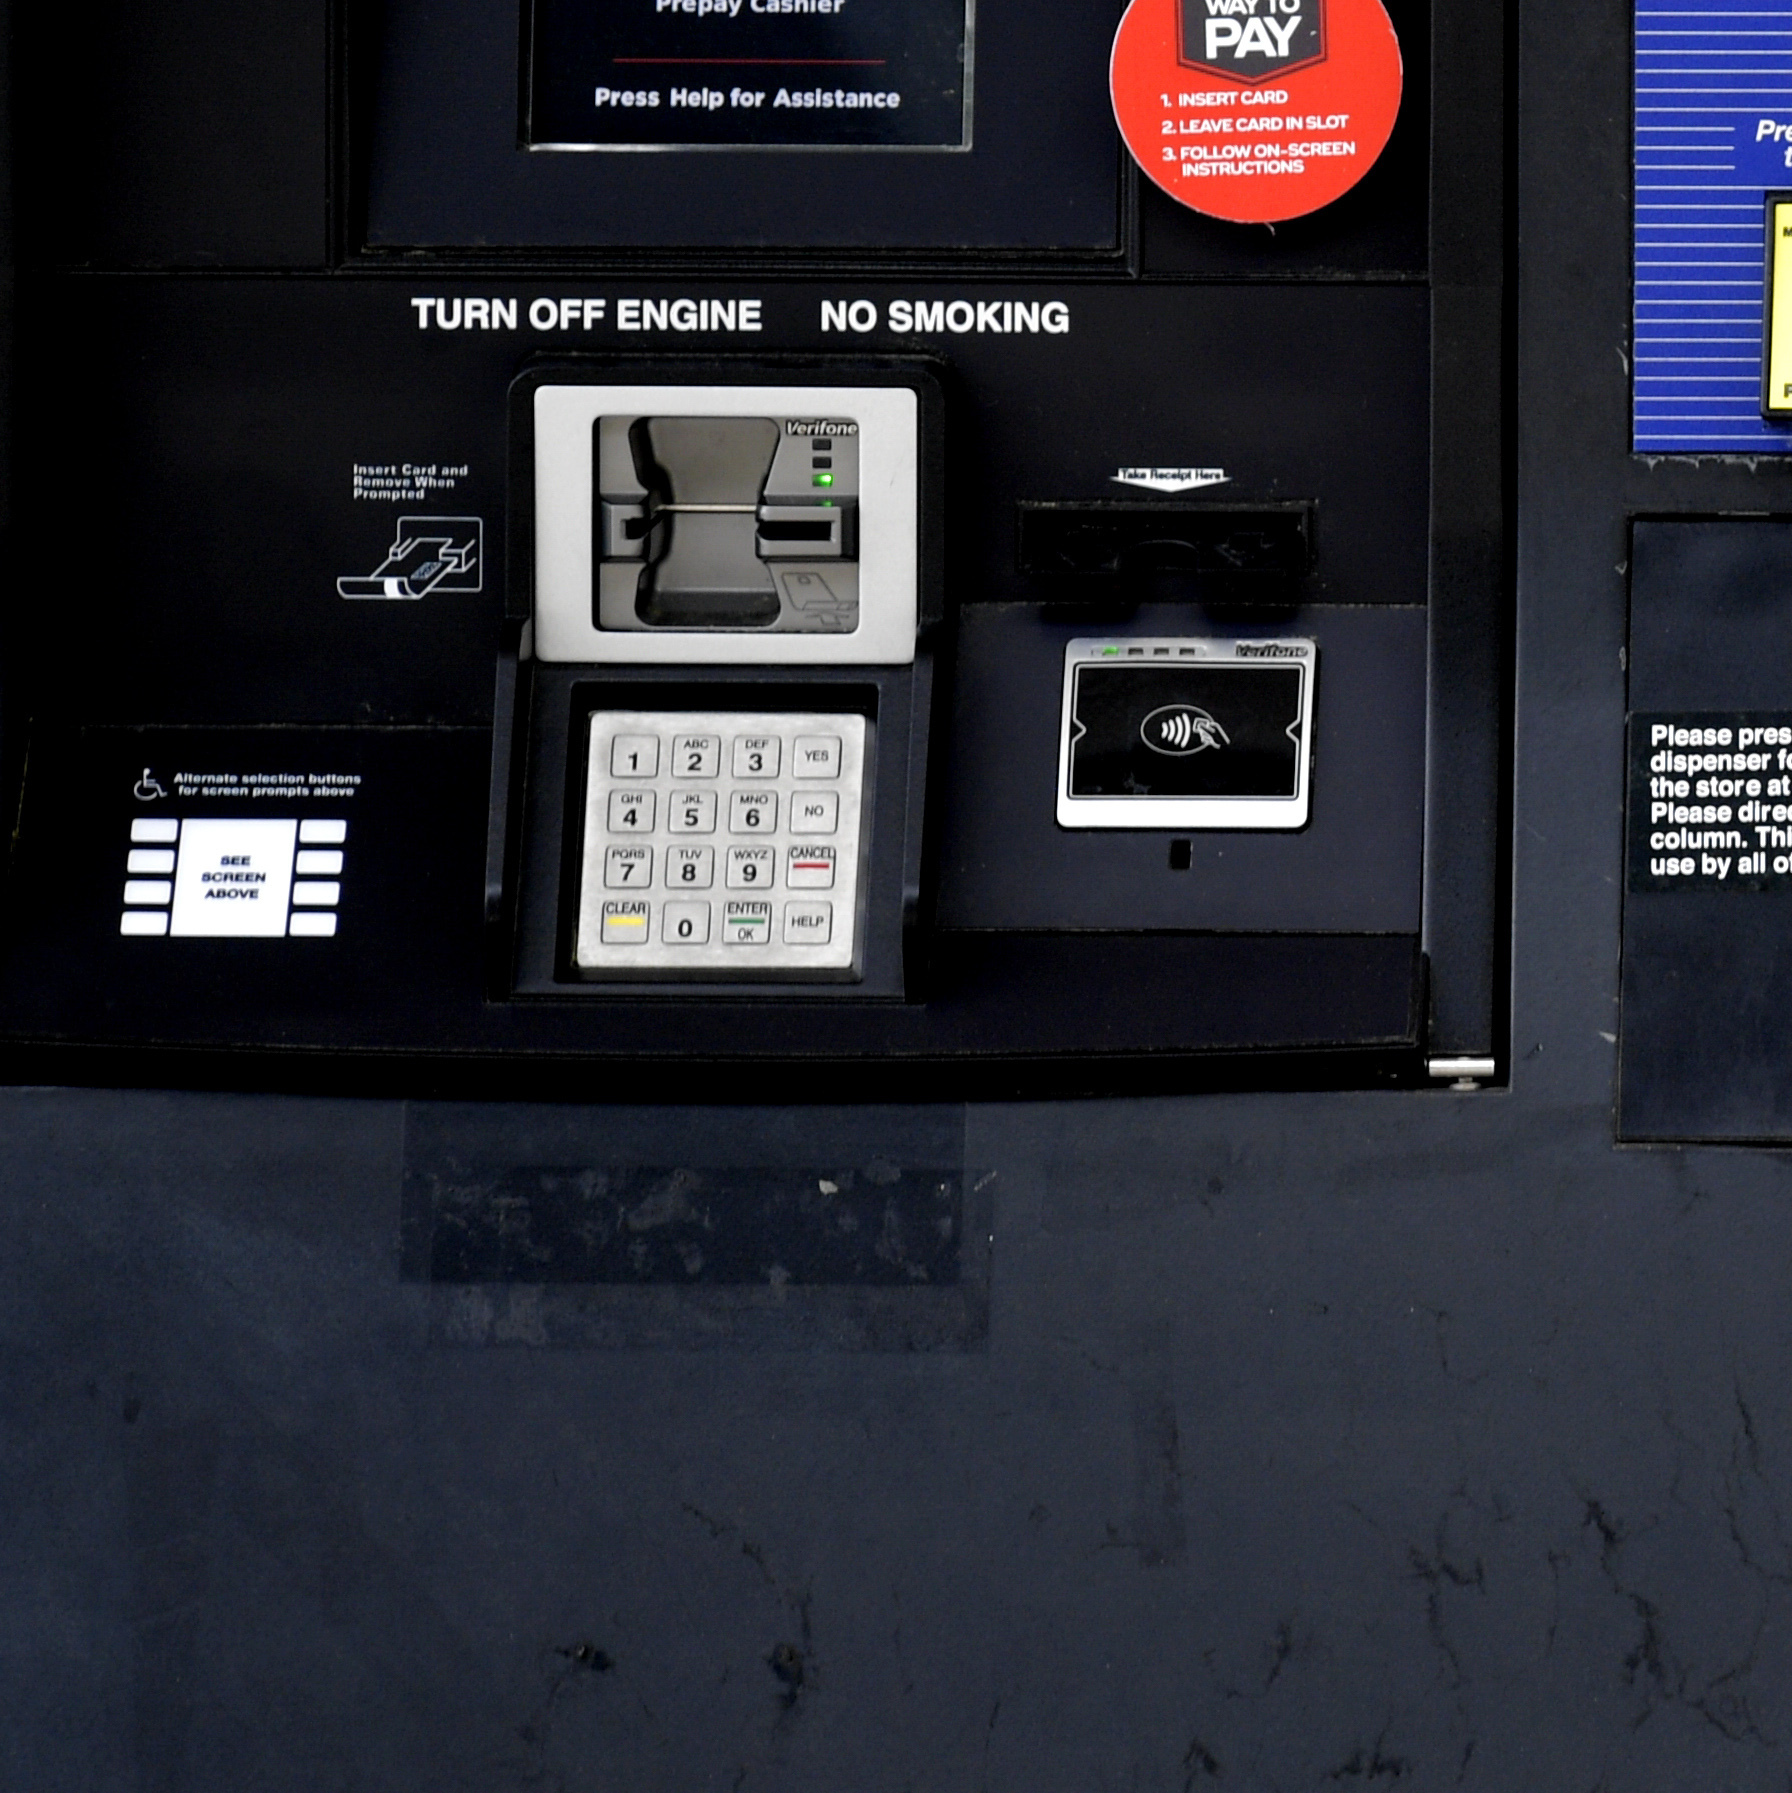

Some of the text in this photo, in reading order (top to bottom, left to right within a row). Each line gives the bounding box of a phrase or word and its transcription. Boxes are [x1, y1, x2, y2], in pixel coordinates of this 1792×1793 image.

[1205, 15, 1301, 59] PAY
[595, 88, 900, 110] Press Help for Assistance
[1161, 90, 1288, 107] 1. INSERT CARD
[1162, 115, 1349, 134] 2. LEAVE CARD IN SLOT
[1163, 142, 1355, 160] 3. FOLLOW ON-SCREEN
[1183, 160, 1304, 176] INSTRUCTIONS
[411, 298, 762, 331] TURN OFF ENGINE
[822, 300, 1069, 333] NO SMOKING
[354, 464, 467, 475] Insert Card and
[354, 476, 454, 487] Remove When
[354, 488, 424, 501] Prompted
[1652, 725, 1732, 746] Please
[627, 752, 639, 770] 1
[688, 754, 702, 771] 2
[749, 754, 763, 771] 3
[805, 750, 828, 762] YES
[1651, 747, 1771, 774] dispenser
[173, 773, 361, 785] Alternate selection buttons
[1650, 774, 1690, 798] the
[1697, 777, 1762, 797] store
[1767, 775, 1790, 796] at
[178, 785, 354, 798] for screen prompts above
[623, 809, 637, 826] 4
[685, 809, 699, 826] 5
[746, 809, 760, 827] 6
[805, 806, 824, 817] NO
[1652, 802, 1732, 823] Please
[1651, 827, 1747, 849] column.
[220, 856, 251, 866] SEE
[790, 847, 835, 858] CANCEL
[201, 872, 266, 882] SCREEN
[620, 864, 635, 881] 7
[682, 864, 696, 882] 8
[743, 864, 757, 882] 9
[204, 889, 259, 899] ABOVE
[606, 903, 646, 914] CLEAR
[728, 903, 768, 915] ENTER
[678, 920, 692, 938] 0
[791, 917, 824, 928] HELP
[737, 929, 753, 940] OK
